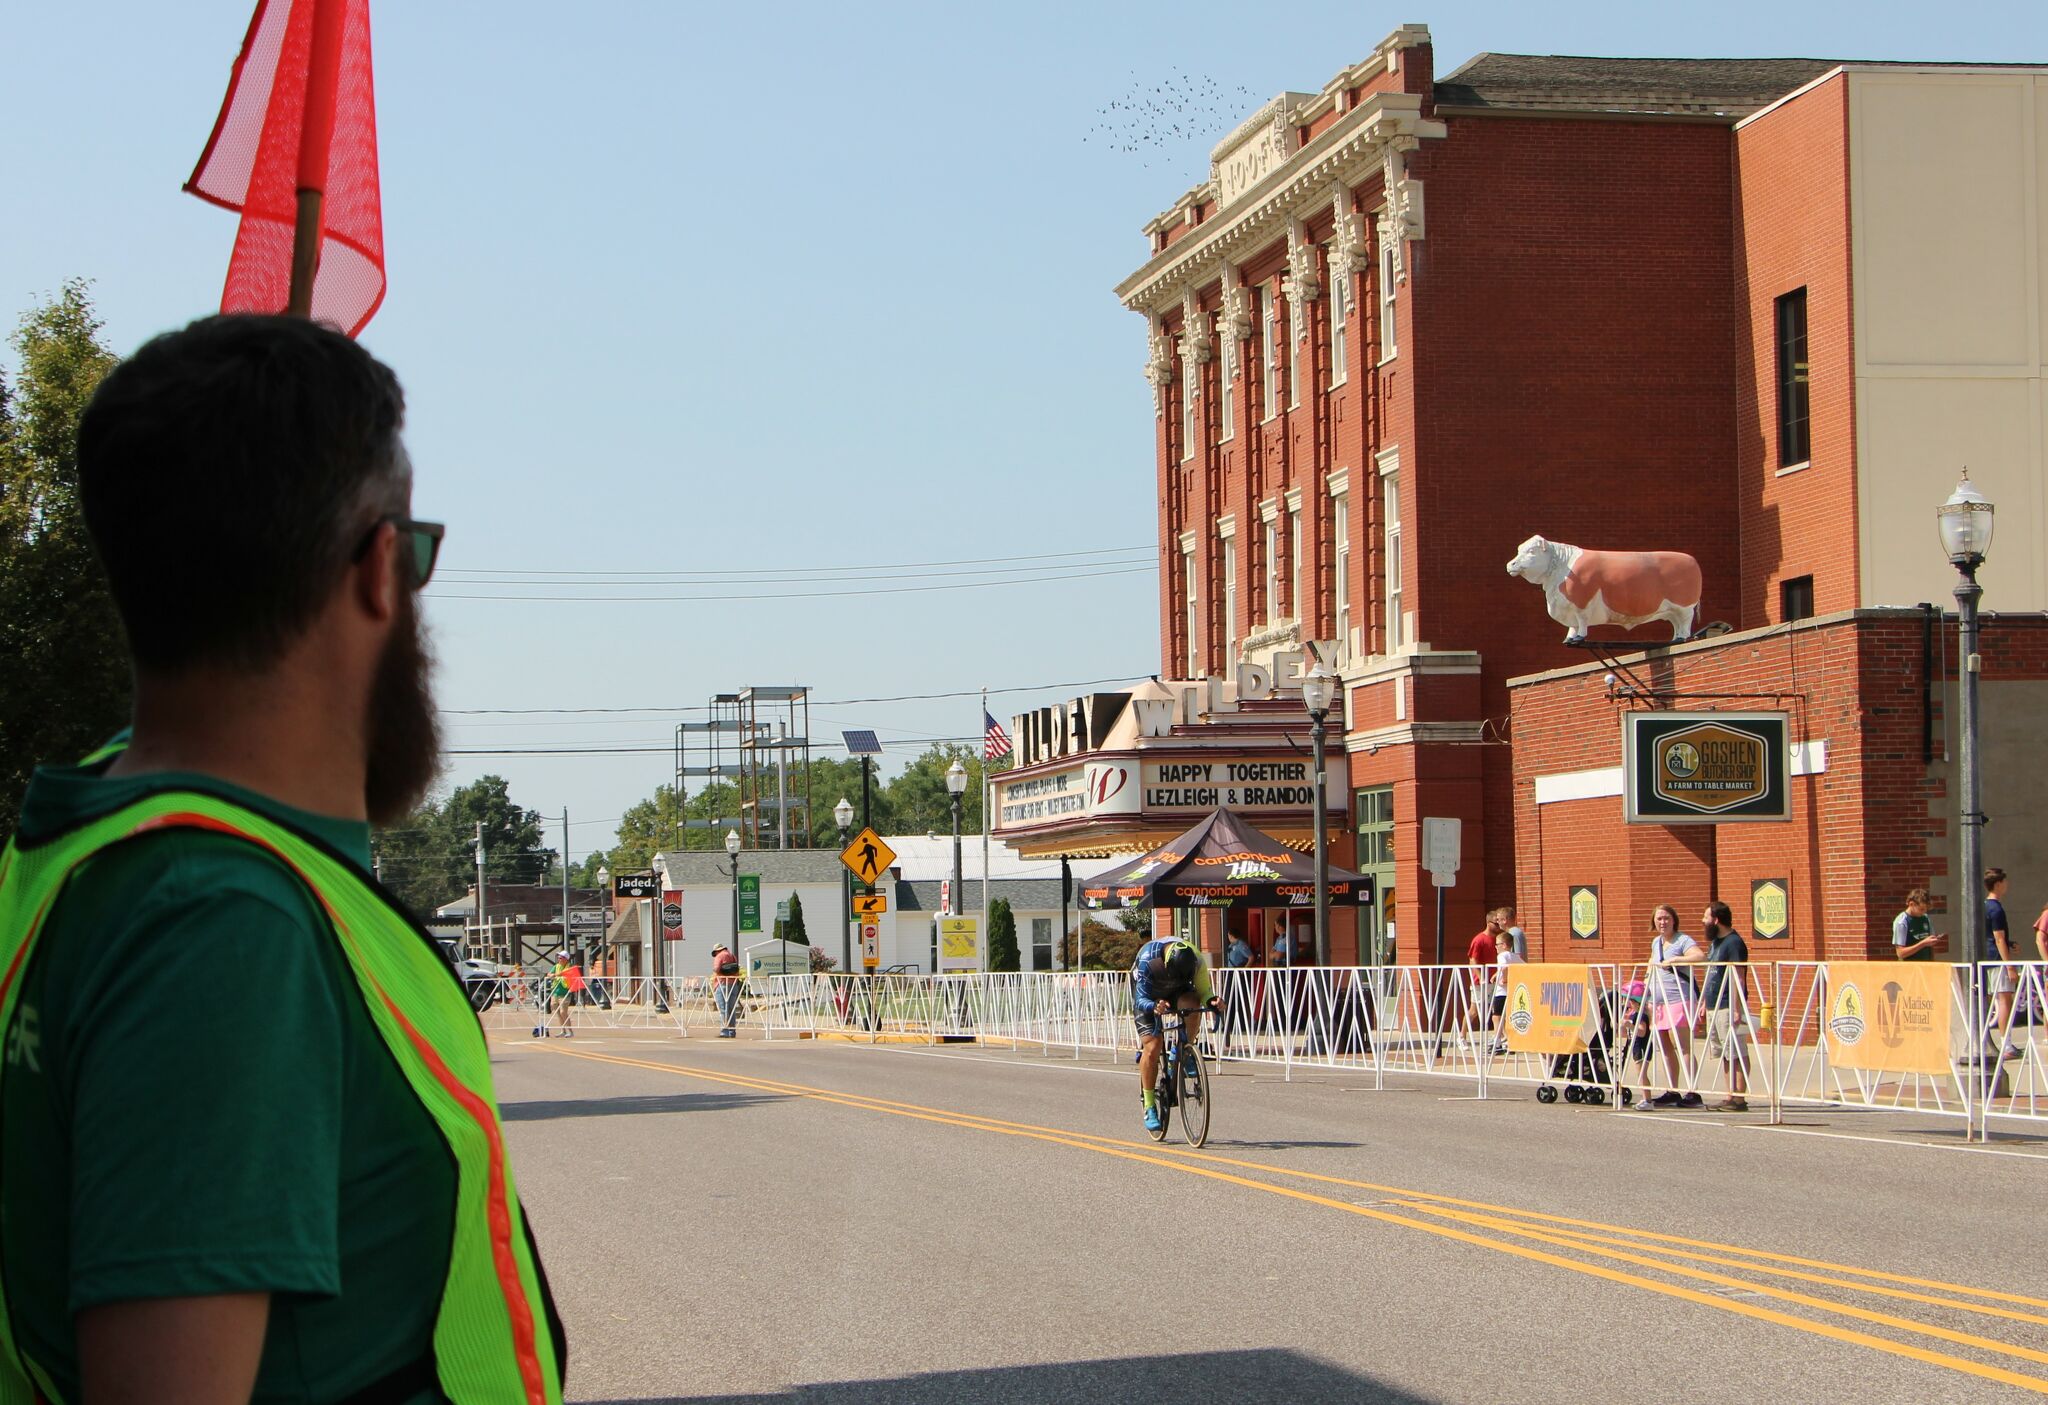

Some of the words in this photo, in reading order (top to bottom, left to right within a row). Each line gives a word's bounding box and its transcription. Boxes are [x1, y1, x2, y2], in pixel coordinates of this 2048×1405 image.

[1132, 639, 1343, 737] WILDEY
[1011, 693, 1102, 769] WILDEY
[1701, 741, 1756, 764] GOSHEN
[1159, 764, 1212, 783] HAPPY
[1227, 763, 1306, 782] TOGETHER
[1702, 765, 1735, 779] BUTCHER
[1736, 765, 1756, 779] SHOP
[1668, 782, 1673, 790] A
[1674, 782, 1692, 790] FARM
[1694, 782, 1703, 790] TO
[1704, 782, 1724, 790] TABLE
[1725, 782, 1752, 790] MARKET
[1146, 789, 1218, 807] LEZLEIGH
[1228, 789, 1238, 804] &
[1243, 787, 1315, 806] BRANDON
[1194, 852, 1293, 866] cannonball
[1226, 870, 1282, 880] racing
[619, 878, 655, 889] jaded.
[1276, 882, 1349, 895] cannoball
[1176, 885, 1248, 897] cannonball
[1207, 898, 1233, 907] racing
[1550, 982, 1584, 1016] WILSON
[1902, 1011, 1930, 1025] Mutual
